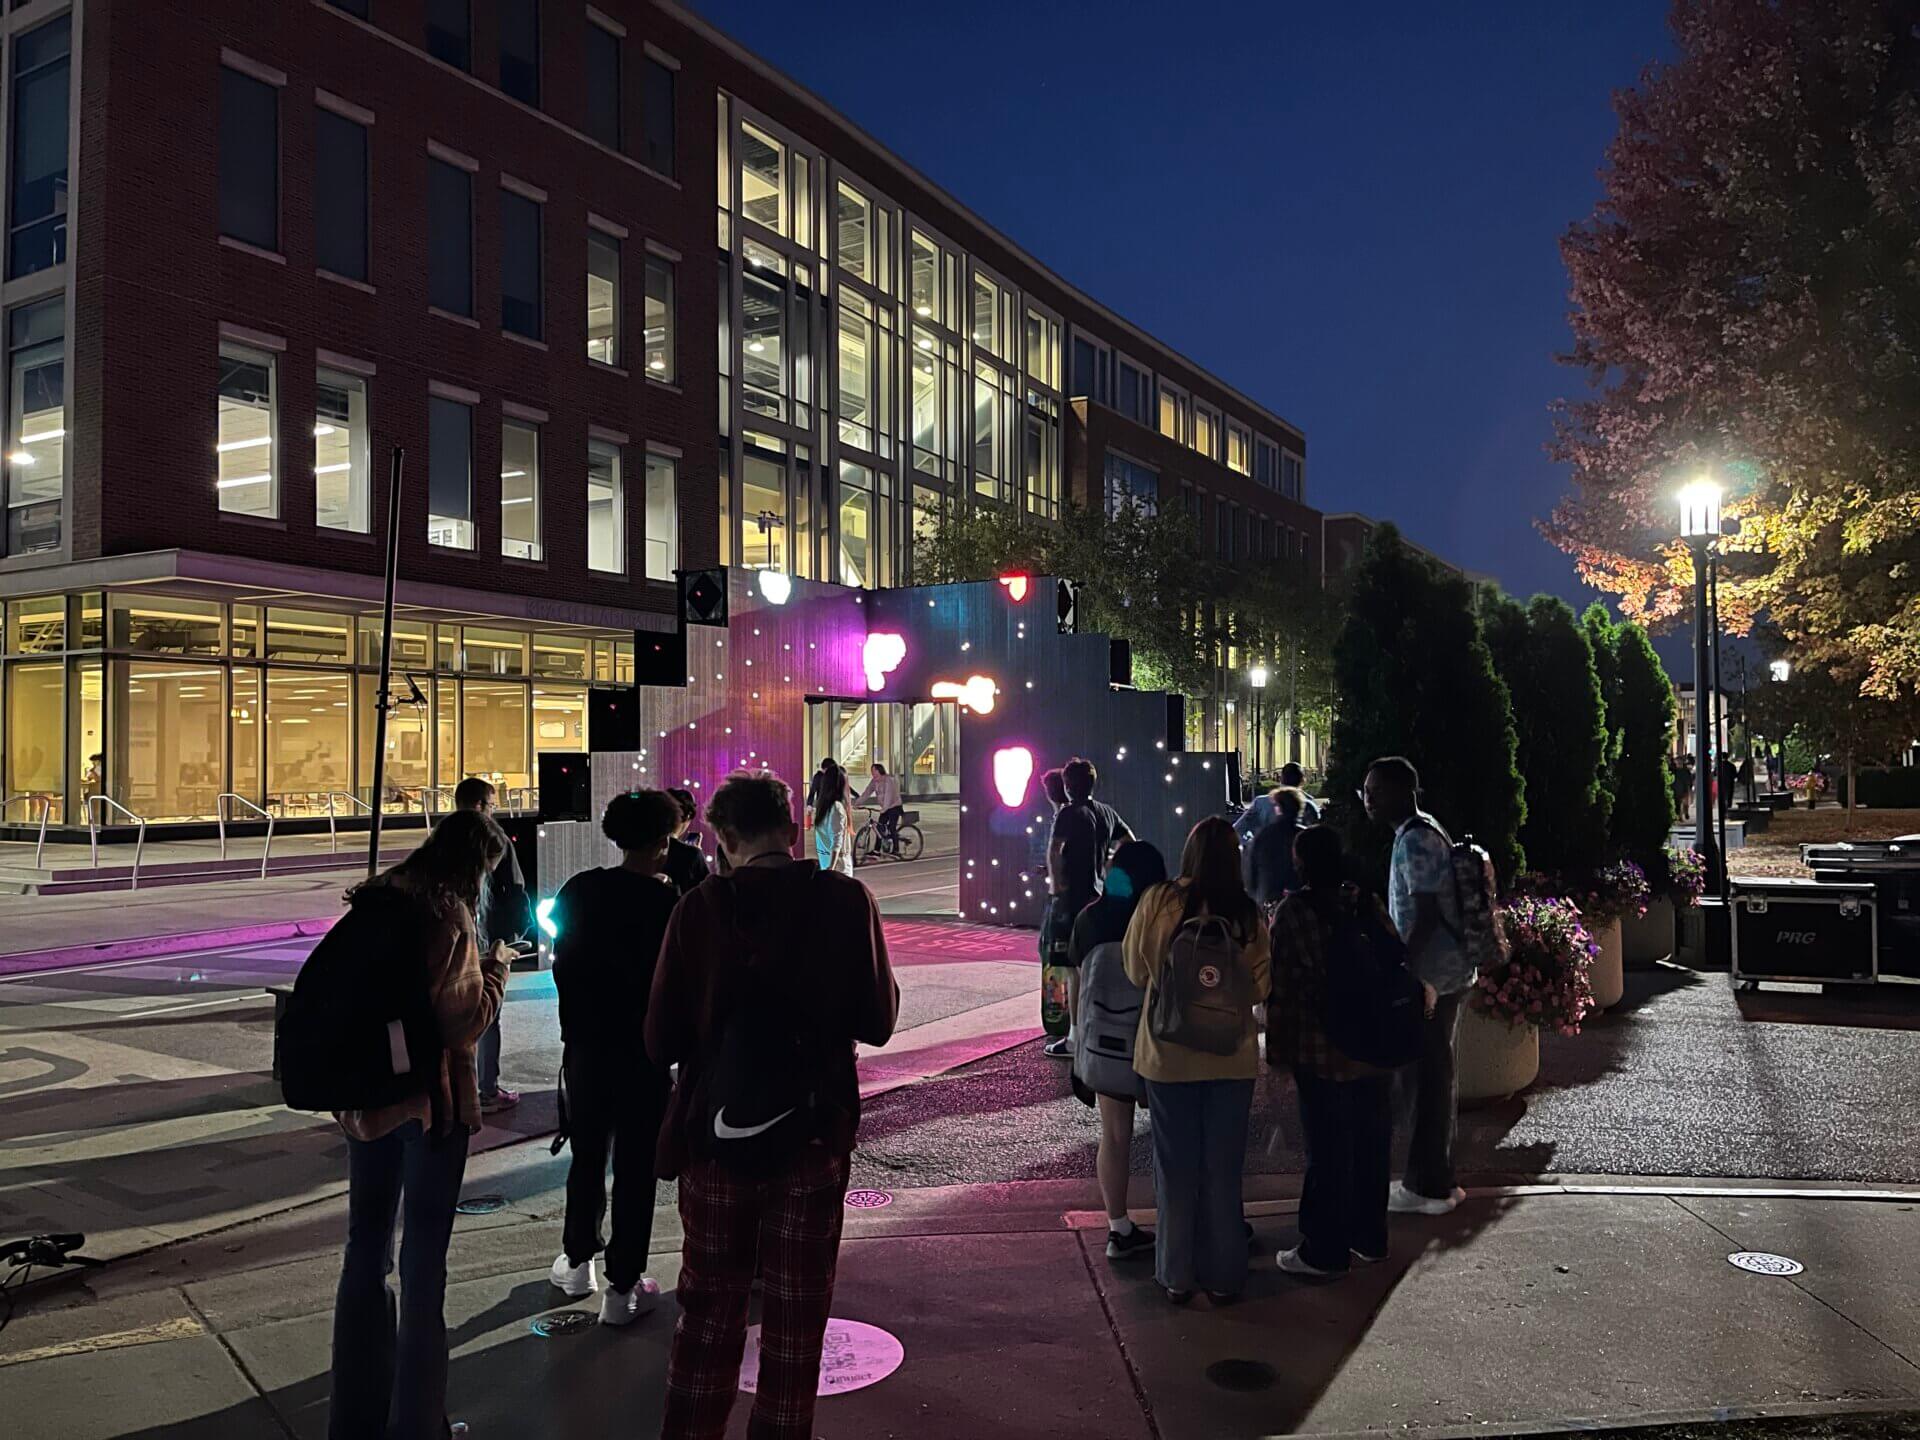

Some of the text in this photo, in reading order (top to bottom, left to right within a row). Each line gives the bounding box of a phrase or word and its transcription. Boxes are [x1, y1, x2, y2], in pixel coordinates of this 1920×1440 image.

[953, 930, 1034, 943] ONE
[1776, 930, 1817, 945] PRG
[917, 939, 1015, 952] STEP
